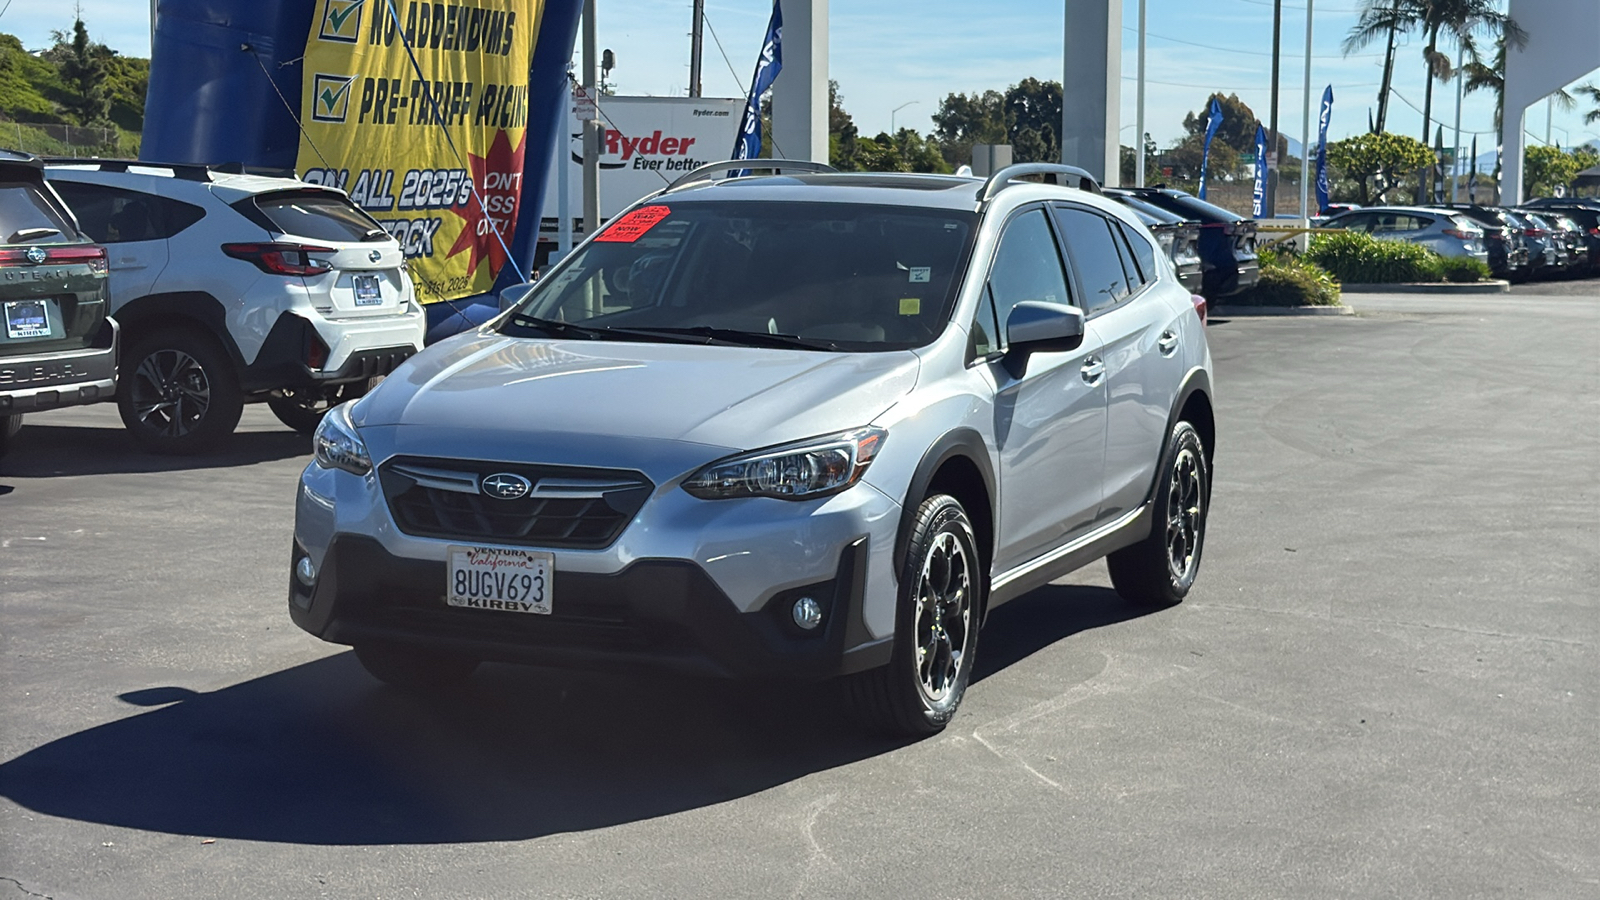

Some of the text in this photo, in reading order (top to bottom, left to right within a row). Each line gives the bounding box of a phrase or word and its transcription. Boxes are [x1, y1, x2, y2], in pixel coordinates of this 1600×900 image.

[370, 0, 396, 47] NO
[358, 77, 473, 126] PRE-TARIFF
[692, 108, 730, 117] Ryder.com
[605, 129, 696, 160] Ryder
[633, 157, 708, 171] Ever better
[350, 170, 395, 210] ALL
[398, 169, 473, 210] 2025's
[483, 171, 522, 191] ON'T
[482, 194, 515, 214] ISS
[476, 218, 509, 236] OT!
[381, 218, 442, 259] TOCK
[470, 552, 533, 571] California
[474, 547, 527, 557] VENTURA
[455, 569, 544, 603] 8UGV693
[467, 597, 532, 611] KIRBY
